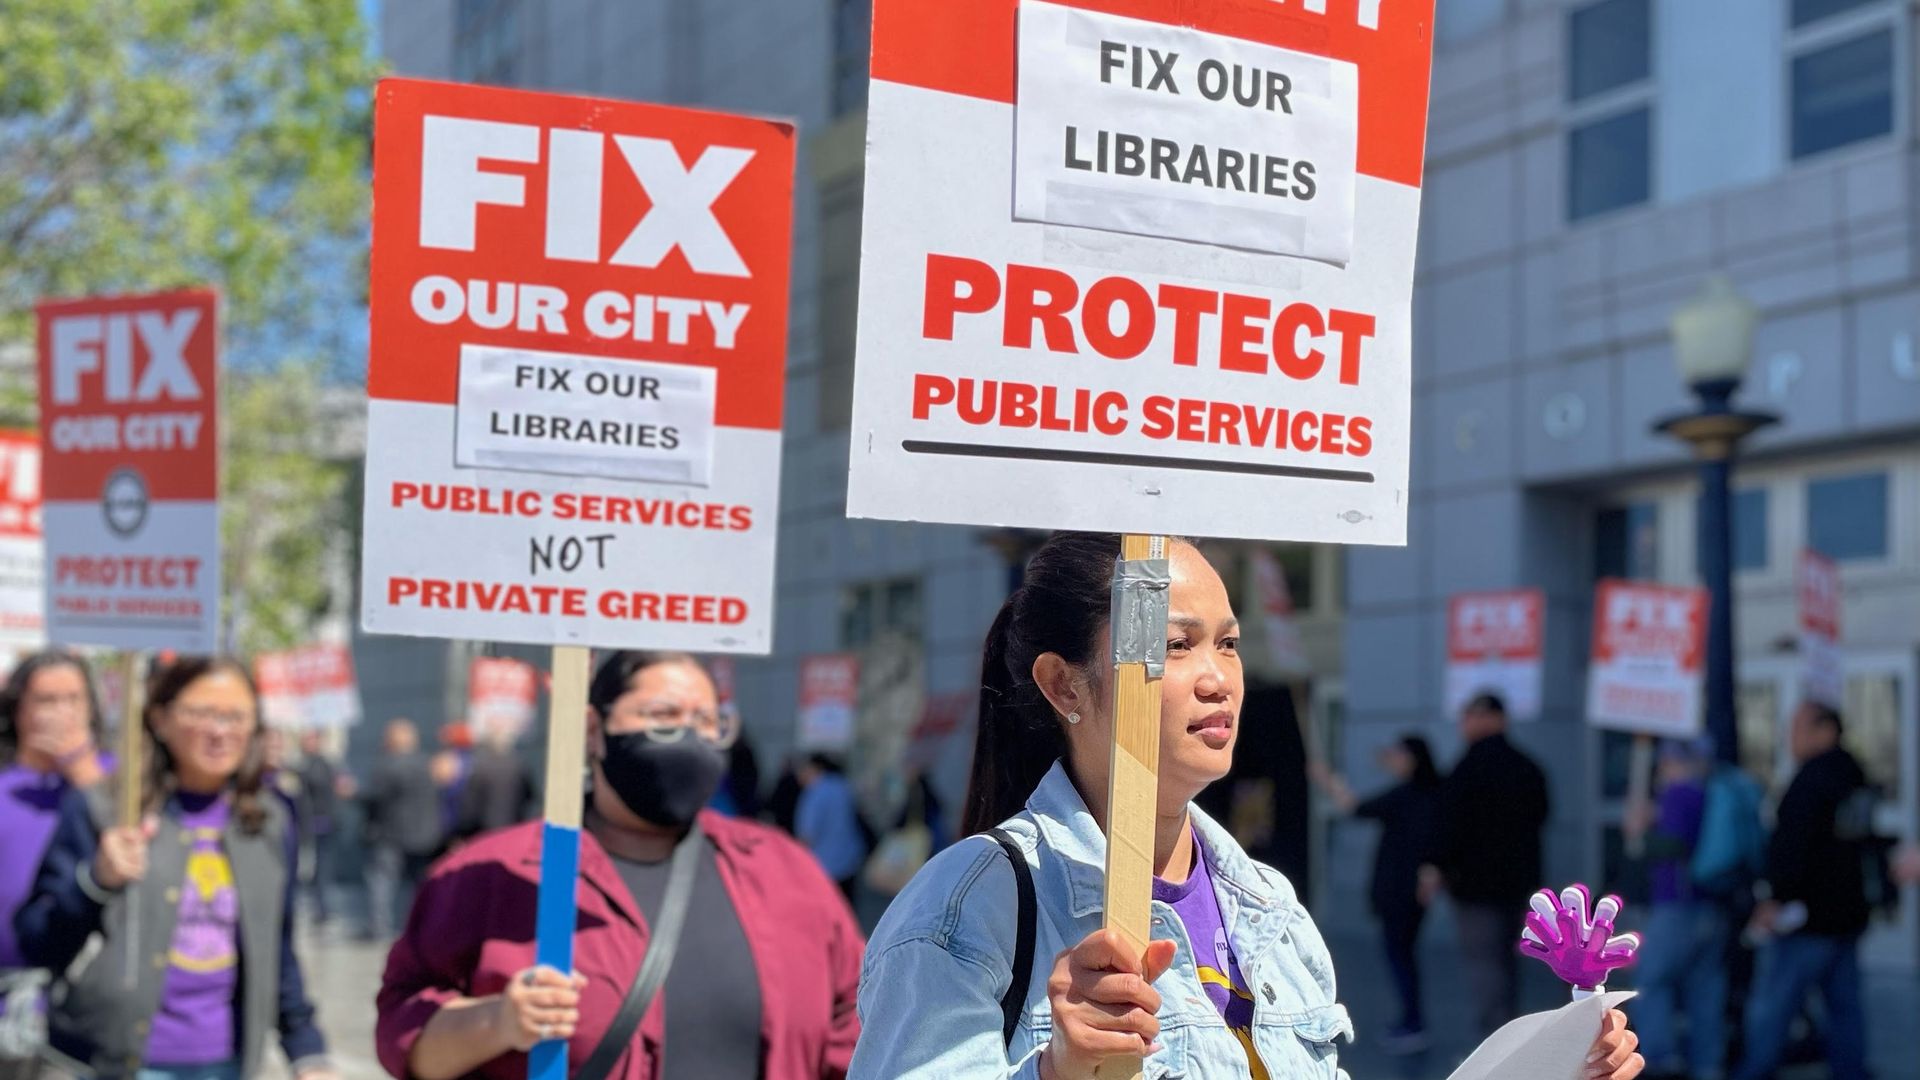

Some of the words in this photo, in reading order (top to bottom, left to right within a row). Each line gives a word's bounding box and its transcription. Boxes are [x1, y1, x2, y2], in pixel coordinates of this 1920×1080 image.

[1100, 40, 1179, 94] FIX
[1197, 59, 1292, 114] OUR
[1064, 125, 1316, 202] LIBRARIES
[419, 114, 758, 279] FIX
[410, 275, 569, 334] OUR
[583, 290, 751, 349] CITY
[922, 252, 1377, 387] PROTECT
[50, 307, 202, 406] FIX
[515, 365, 571, 393] FIX
[585, 371, 661, 401] OUR
[50, 415, 120, 453] OUR
[122, 411, 203, 450] CITY
[490, 411, 680, 450] LIBRARIES
[912, 373, 1129, 436] PUBLIC
[1140, 395, 1373, 457] SERVICES
[391, 481, 542, 517] PUBLIC
[552, 493, 753, 532] SERVICES
[54, 554, 203, 589] PROTECT
[529, 534, 616, 576] NOT
[387, 576, 587, 617] PRIVATE
[597, 589, 749, 626] GREED
